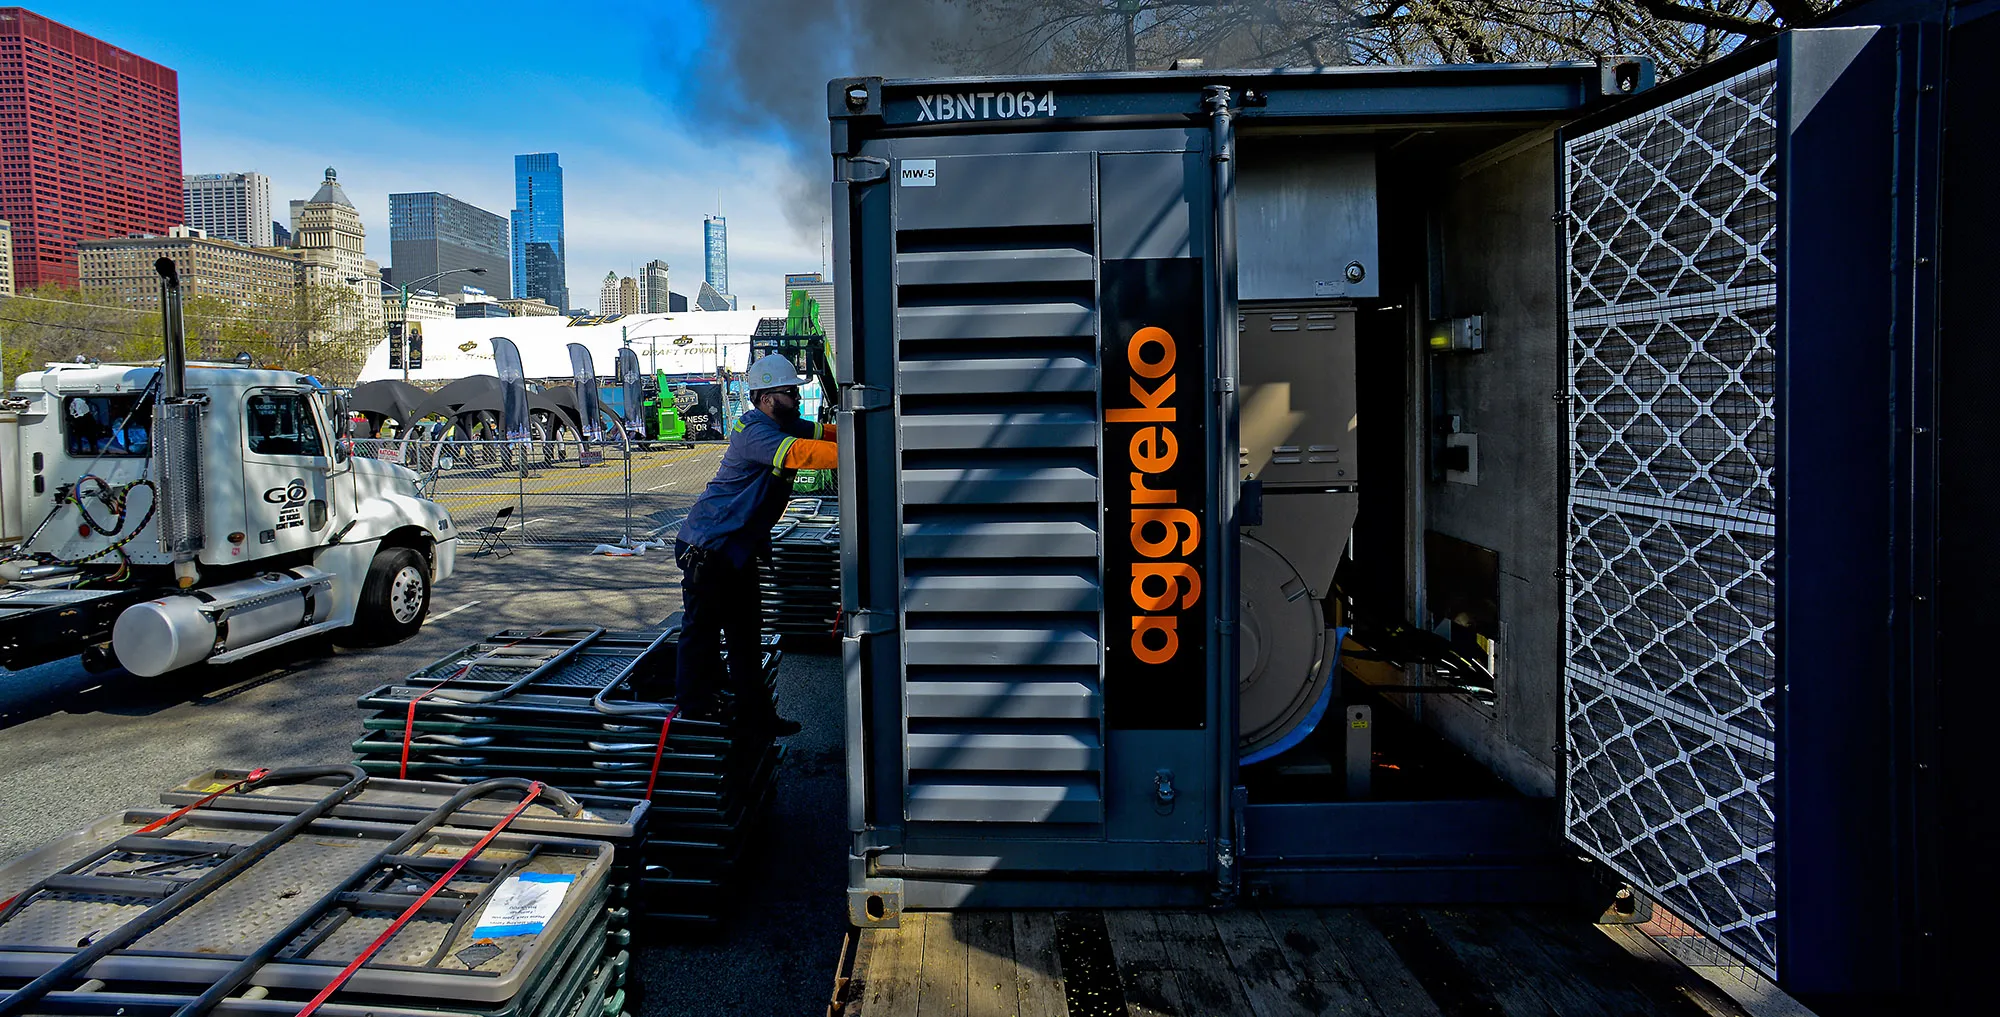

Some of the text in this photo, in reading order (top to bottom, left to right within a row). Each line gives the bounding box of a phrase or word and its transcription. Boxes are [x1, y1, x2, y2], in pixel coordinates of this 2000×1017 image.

[916, 90, 1057, 121] XBNT064
[902, 169, 935, 178] MW-5
[683, 347, 717, 355] TOWN
[686, 415, 709, 423] NESS
[1105, 326, 1201, 664] aggreko
